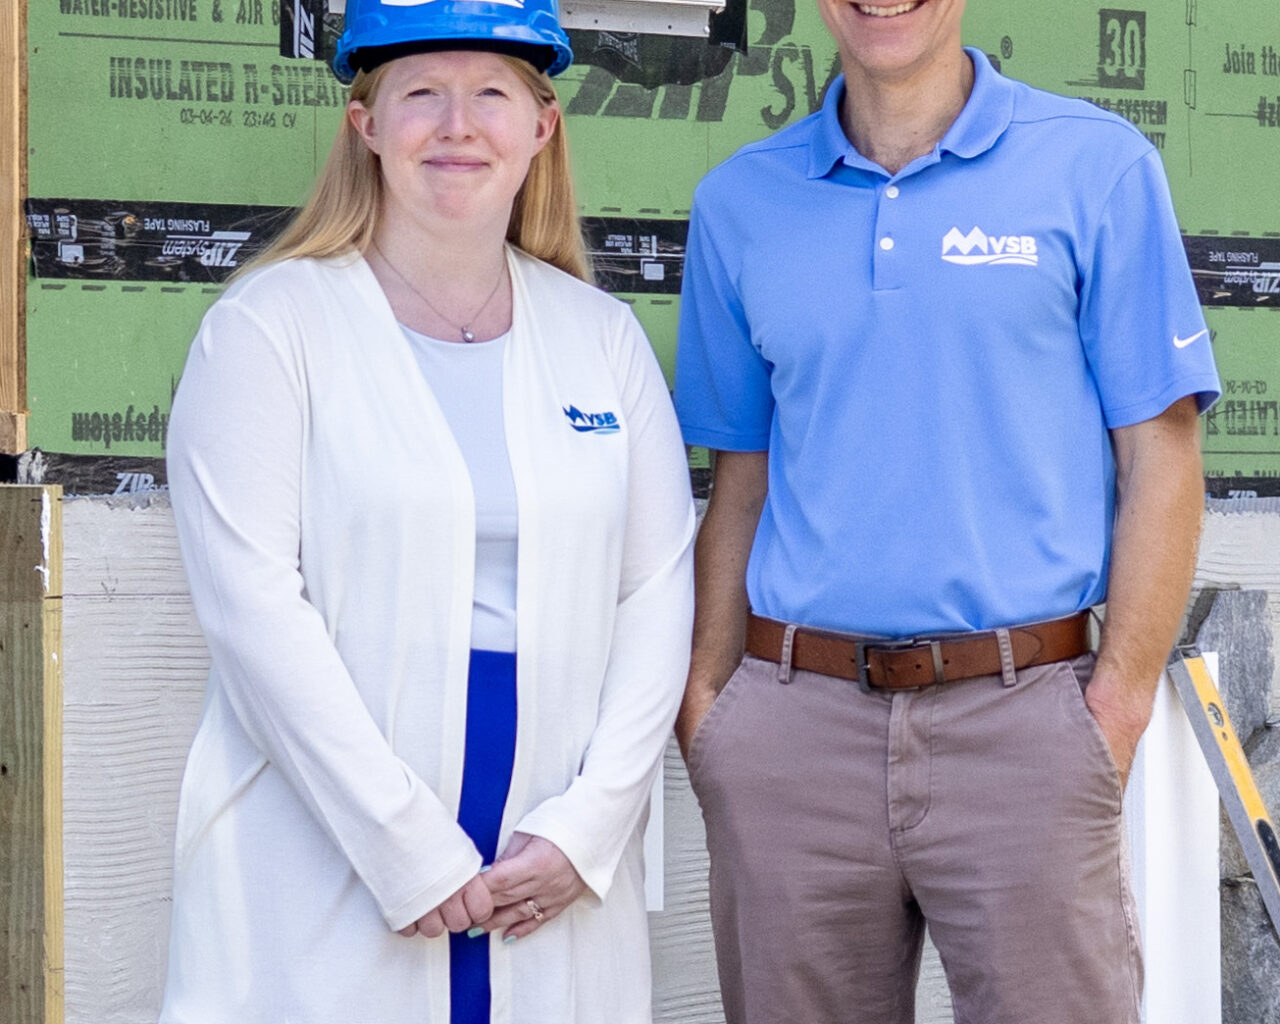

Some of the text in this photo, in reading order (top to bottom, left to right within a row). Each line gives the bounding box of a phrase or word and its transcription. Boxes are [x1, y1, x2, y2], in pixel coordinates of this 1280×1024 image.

[1104, 18, 1143, 79] 30
[1223, 43, 1257, 75] Join
[108, 56, 349, 108] INSULATED R-SHEAT
[144, 217, 210, 232] FLASHING TAPE
